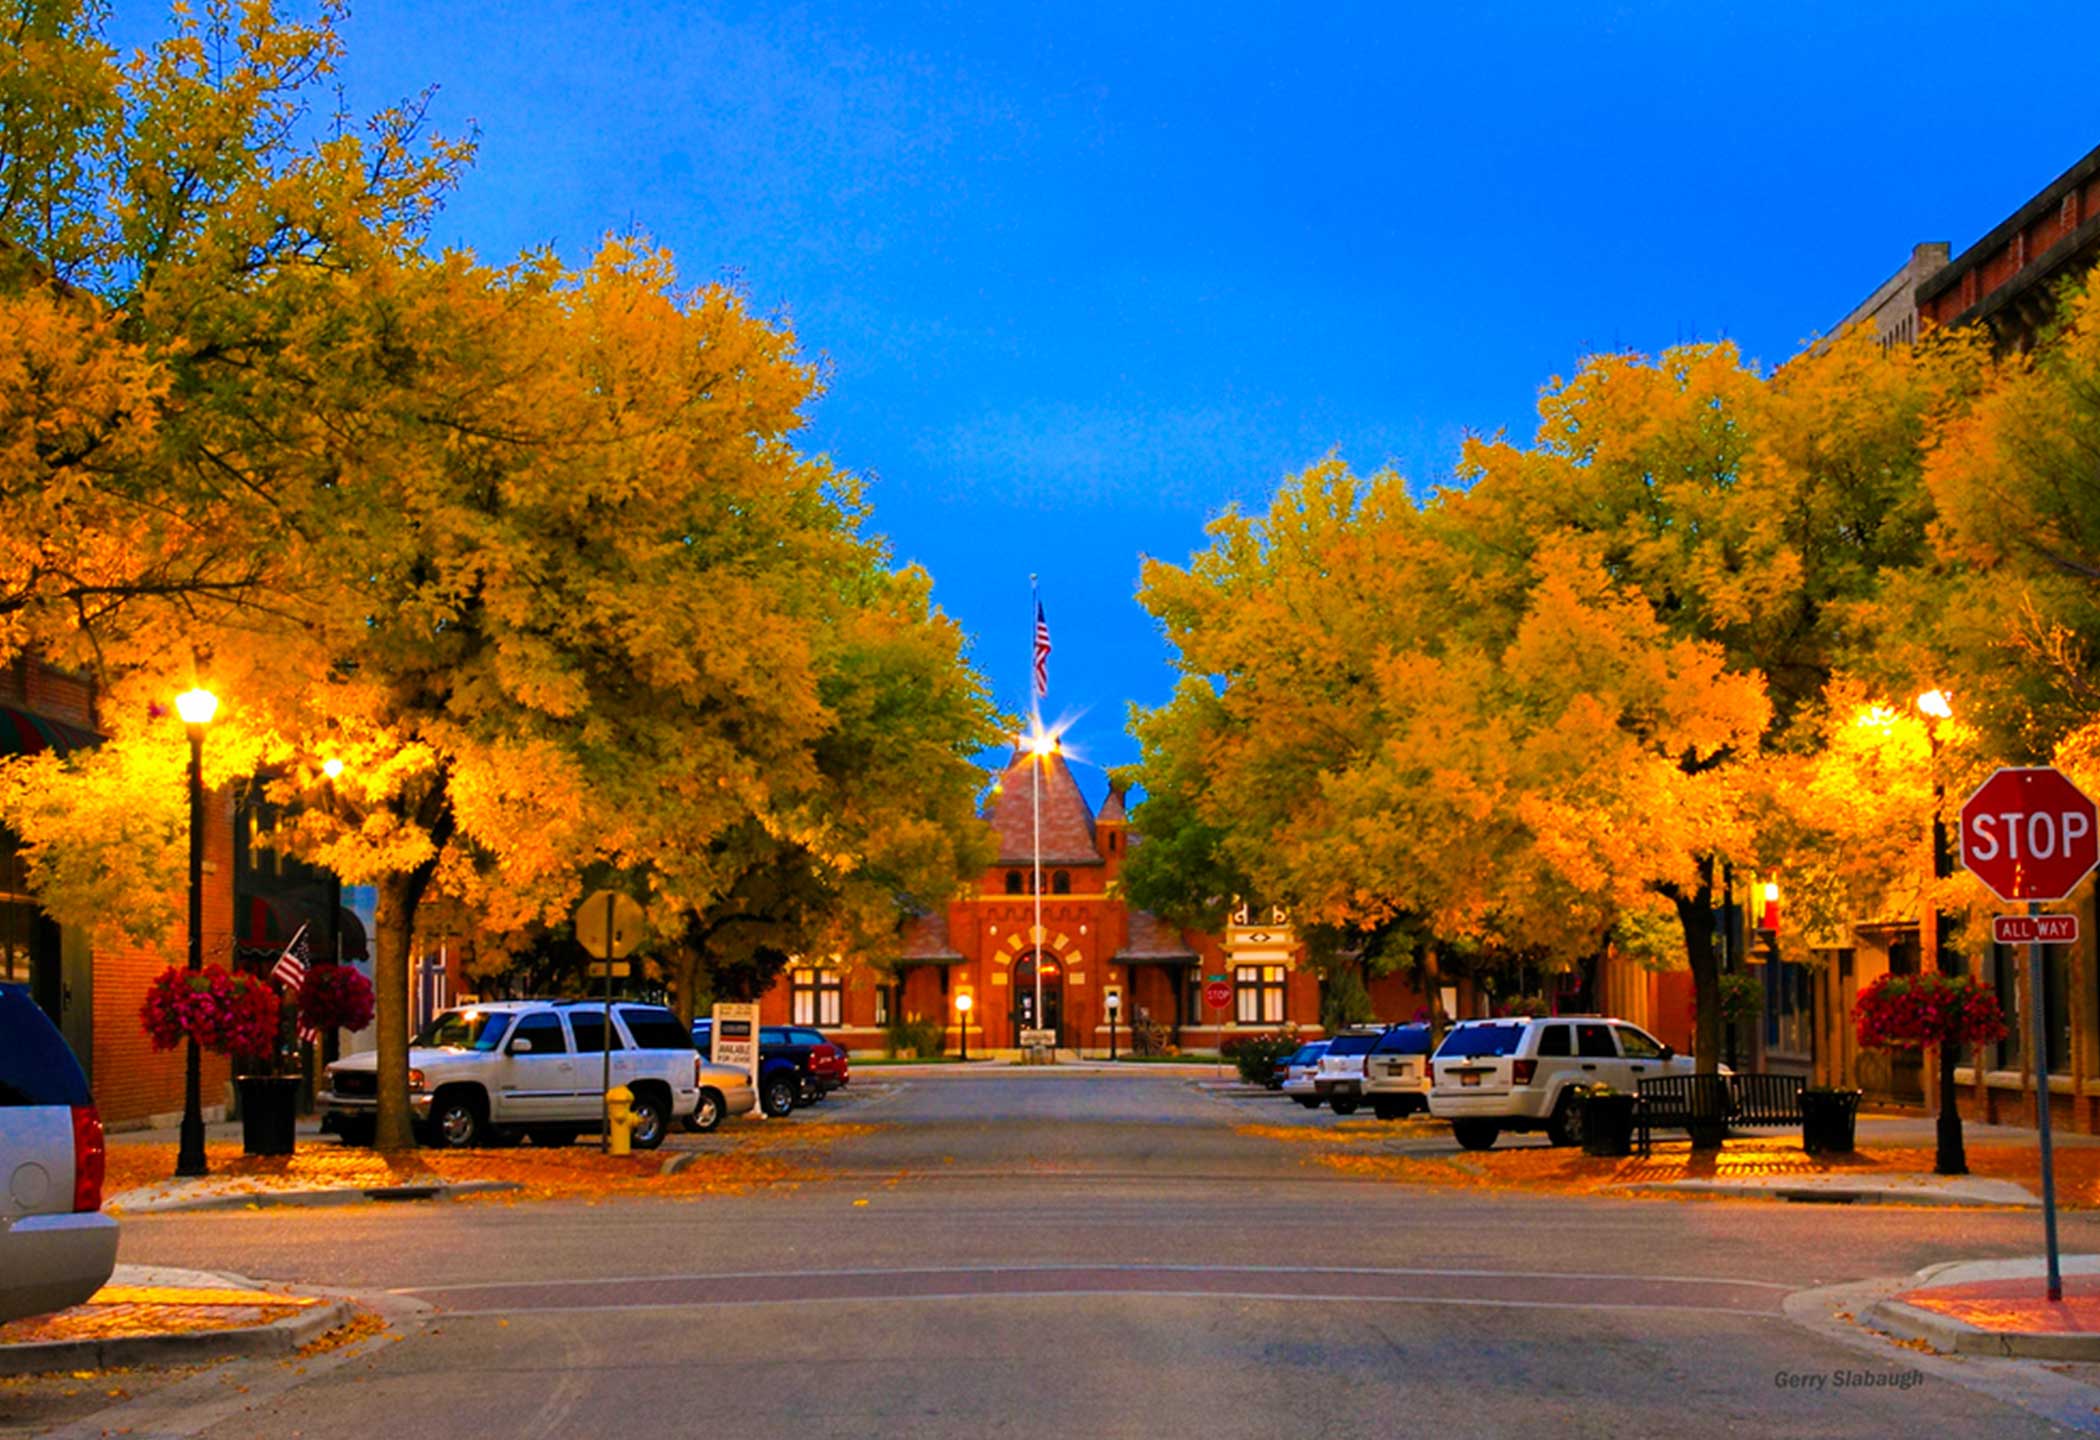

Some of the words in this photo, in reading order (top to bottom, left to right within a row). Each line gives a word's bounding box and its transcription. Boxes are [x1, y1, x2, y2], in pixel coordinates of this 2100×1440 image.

[1971, 811, 2089, 860] STOP
[2002, 922, 2030, 937] ALL
[2037, 921, 2069, 936] WAY
[1207, 990, 1230, 1000] STOP
